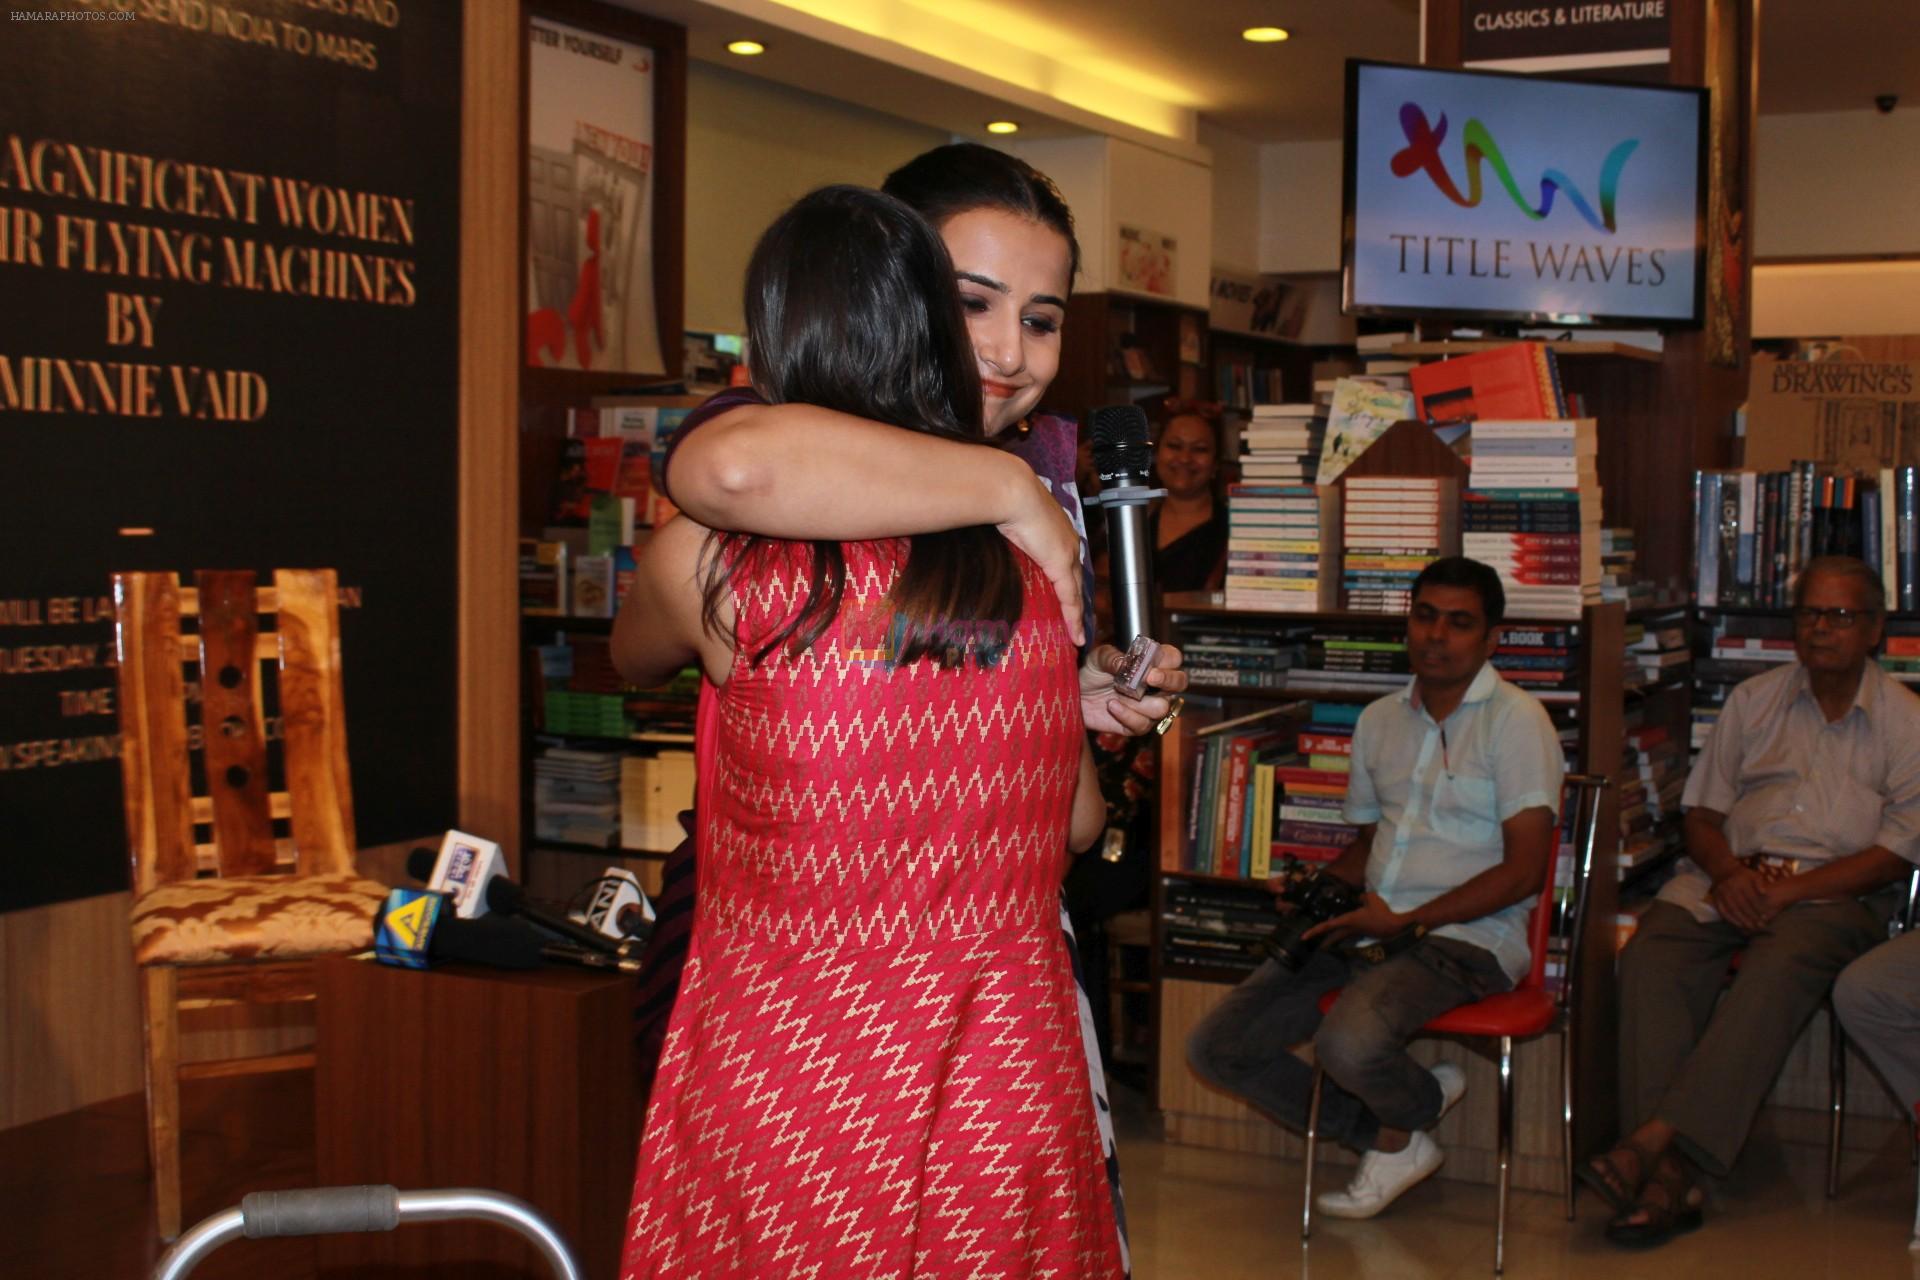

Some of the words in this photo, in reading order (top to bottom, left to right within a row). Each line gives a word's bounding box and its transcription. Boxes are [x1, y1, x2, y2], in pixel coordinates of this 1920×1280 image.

[211, 5, 278, 48] INDIA
[282, 21, 312, 56] TO
[315, 31, 378, 71] MARS
[1474, 9, 1549, 32] CLASSICS
[1554, 7, 1566, 25] &
[1570, 1, 1665, 25] LITERATURE
[271, 175, 414, 246] WOMEN
[56, 213, 212, 285] FLYING
[222, 236, 416, 306] MACHINES
[1390, 233, 1511, 279] TITLE
[1528, 242, 1667, 286] WAVES
[106, 291, 162, 348] BY
[171, 365, 268, 422] VAID
[1771, 374, 1913, 395] DRAWINGS
[1508, 632, 1545, 646] BOOK
